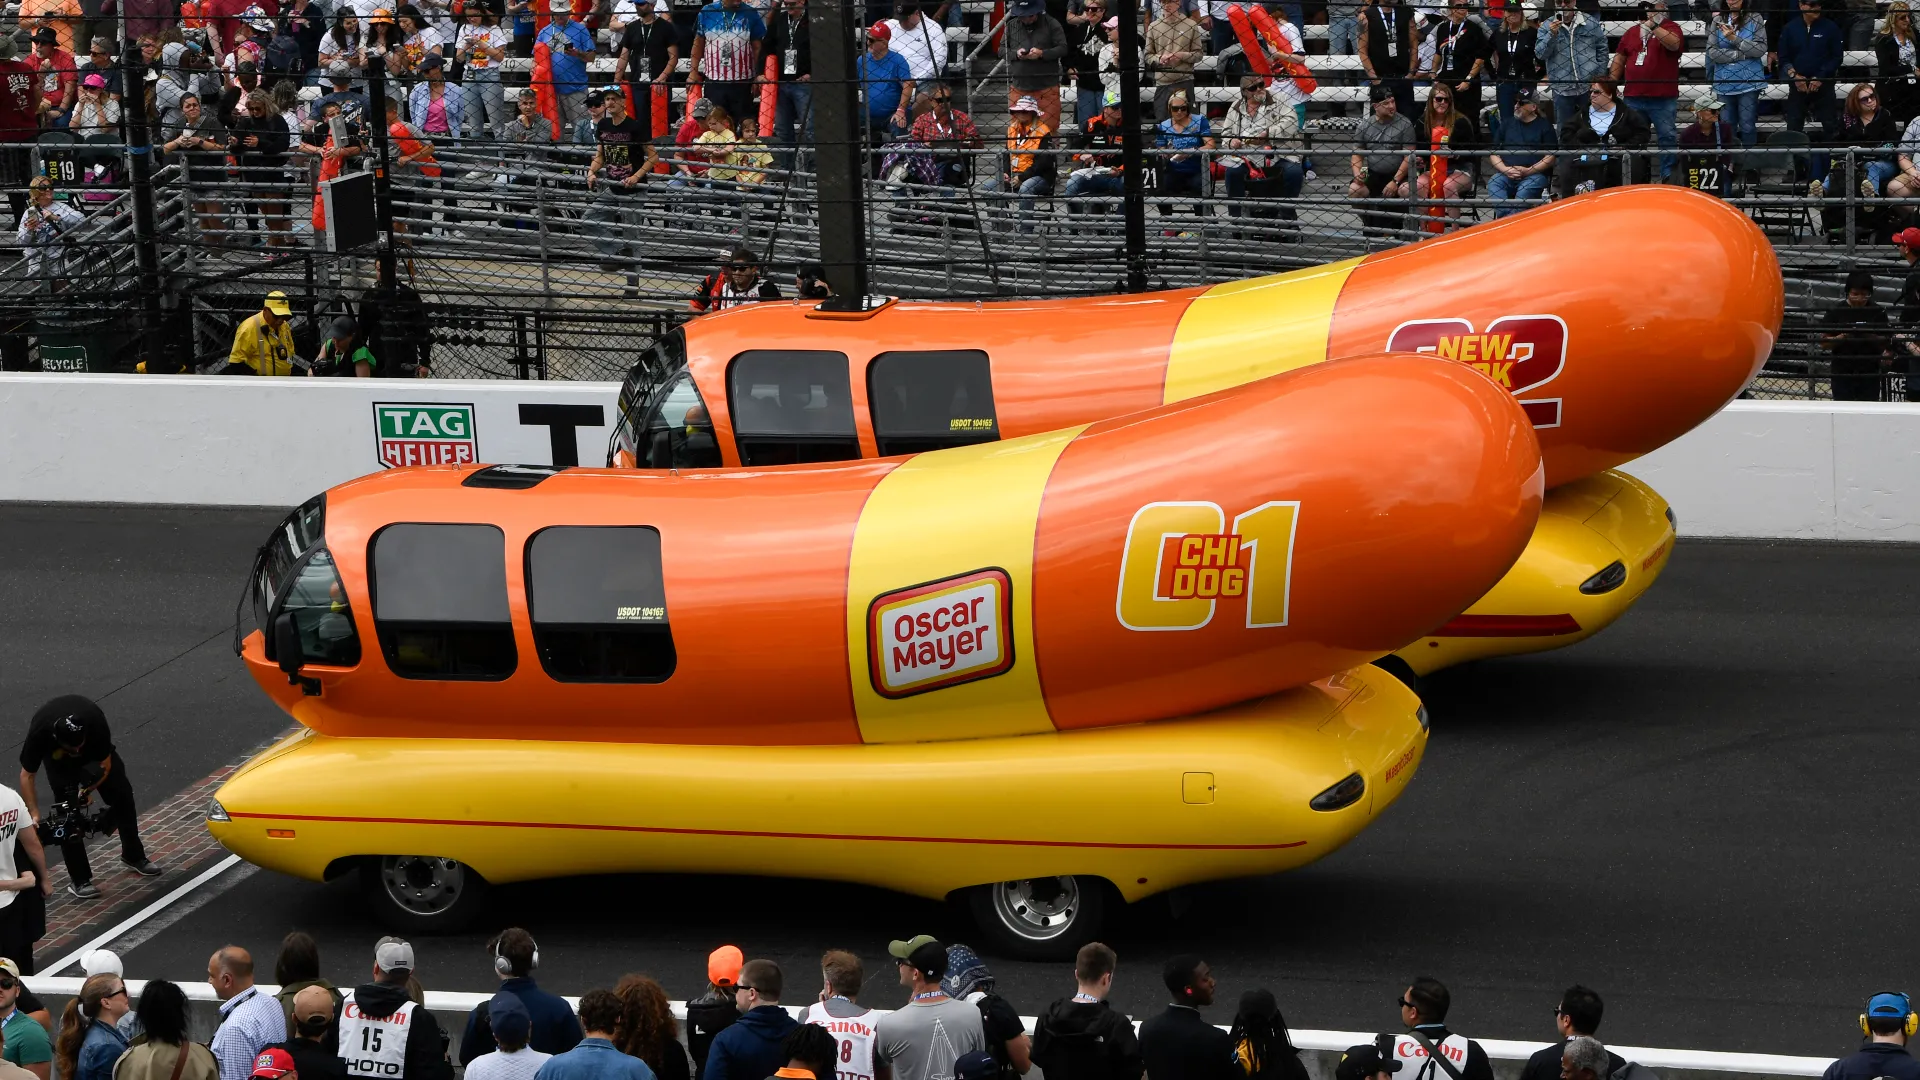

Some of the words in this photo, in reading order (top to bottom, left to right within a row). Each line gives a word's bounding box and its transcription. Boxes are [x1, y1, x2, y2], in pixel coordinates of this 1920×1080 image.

[49, 161, 58, 180] BOX
[60, 161, 75, 181] 19
[1142, 167, 1157, 189] 21
[1689, 168, 1699, 189] BOX
[1699, 168, 1719, 190] 22
[1438, 334, 1511, 362] NEW
[384, 411, 466, 436] TAG
[951, 418, 972, 427] USDOT
[1179, 537, 1240, 567] CHI
[1172, 568, 1245, 598] DOG
[617, 606, 641, 616] USDOT
[642, 607, 664, 616] 104165
[894, 596, 985, 643] Oscar
[892, 625, 989, 673] Mayer
[345, 1003, 407, 1026] Caon
[362, 1026, 383, 1053] 15
[811, 1020, 872, 1037] anon
[836, 1039, 853, 1064] 8
[1397, 1041, 1464, 1063] Caon
[344, 1058, 400, 1075] HOTO
